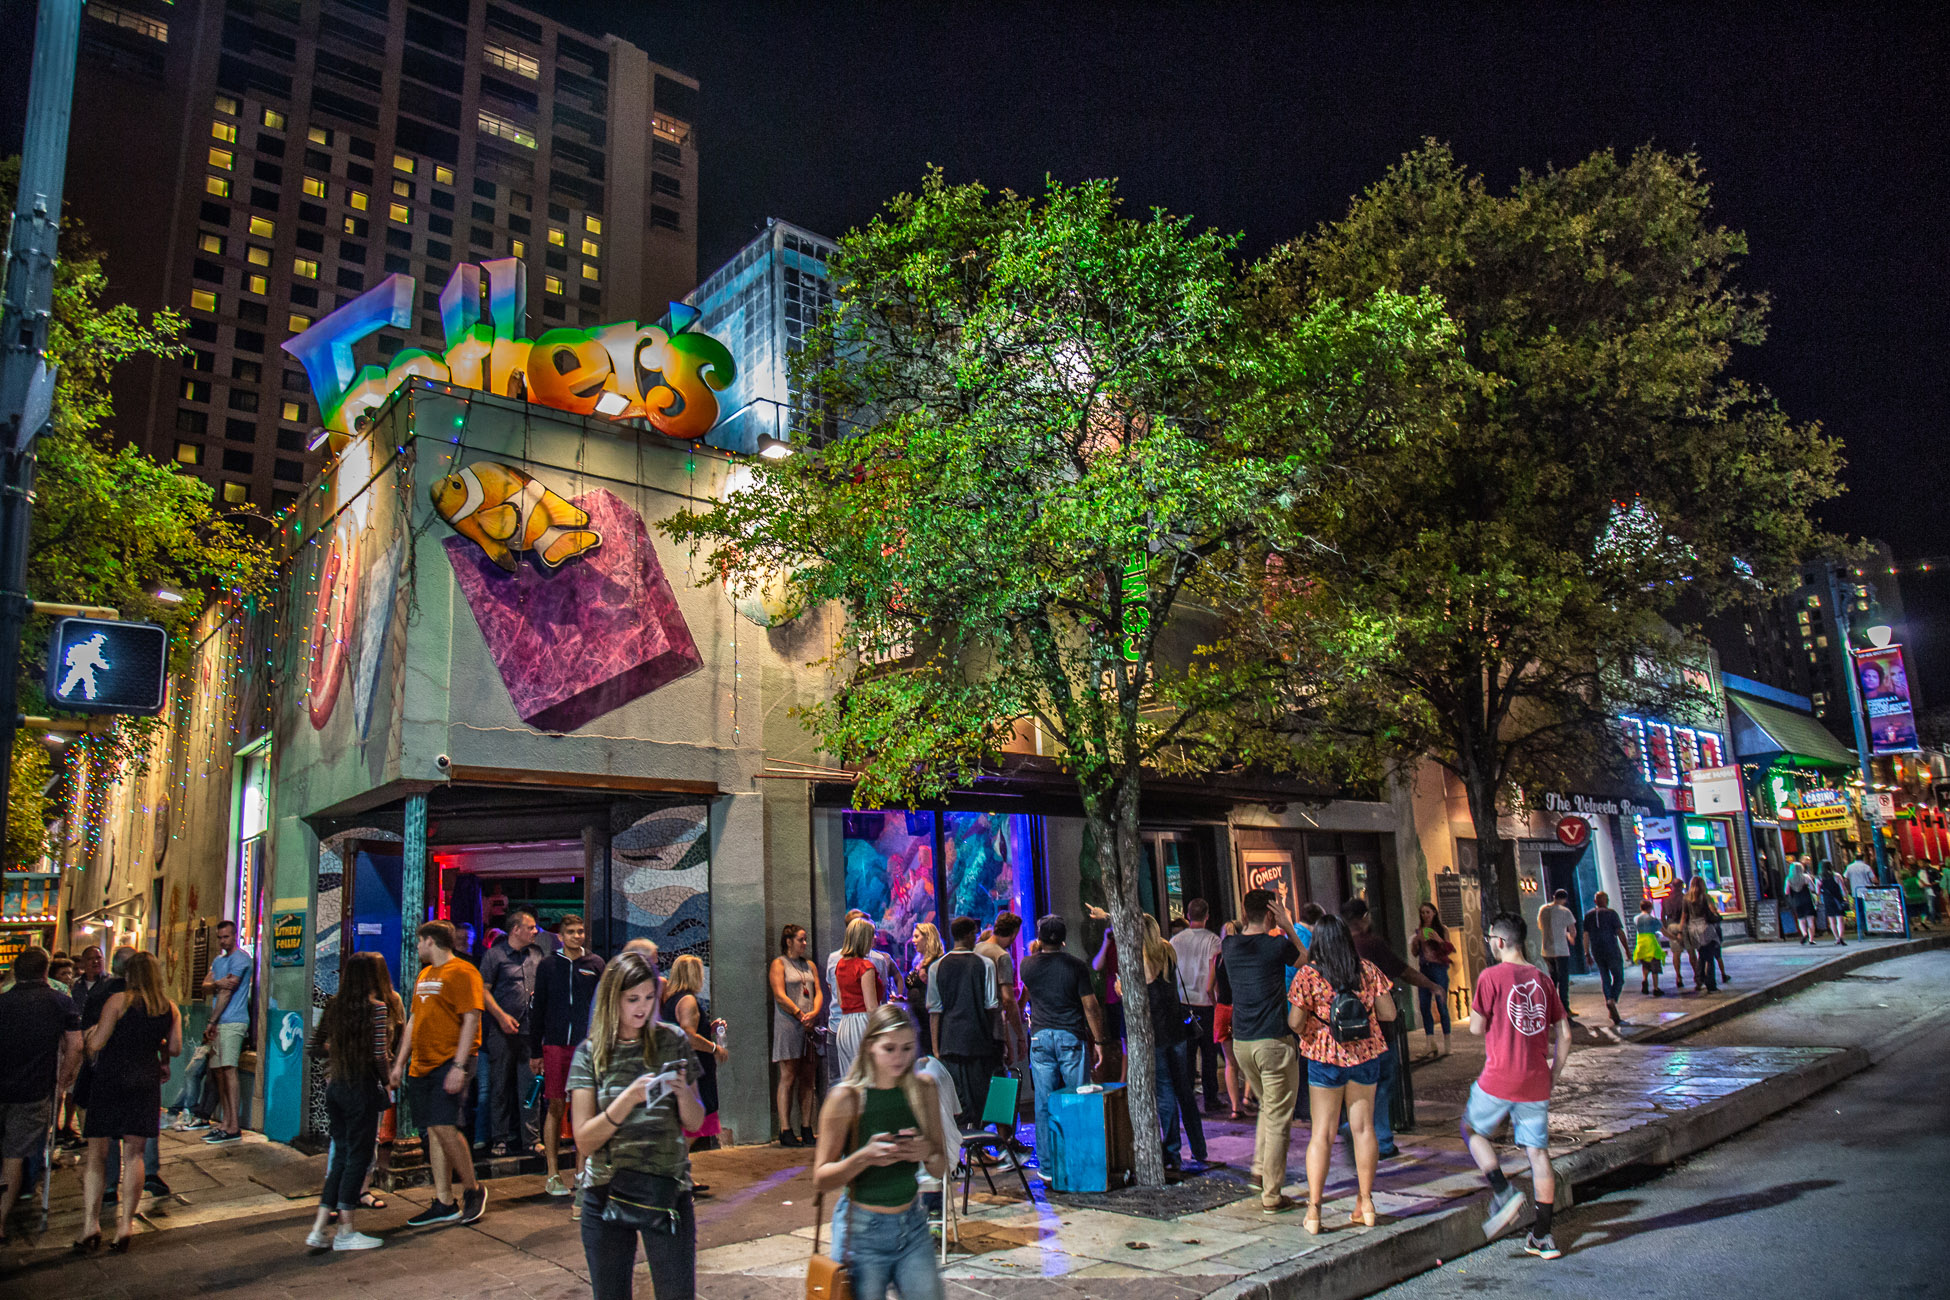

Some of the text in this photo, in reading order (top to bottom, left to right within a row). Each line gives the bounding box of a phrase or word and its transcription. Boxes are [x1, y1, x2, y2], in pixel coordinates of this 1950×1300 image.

[1546, 792, 1651, 816] The Velveeta Room
[1806, 792, 1834, 803] CASINO
[1801, 807, 1846, 818] EL CAMINO
[1560, 824, 1582, 840] V
[1250, 865, 1282, 890] COMEDY
